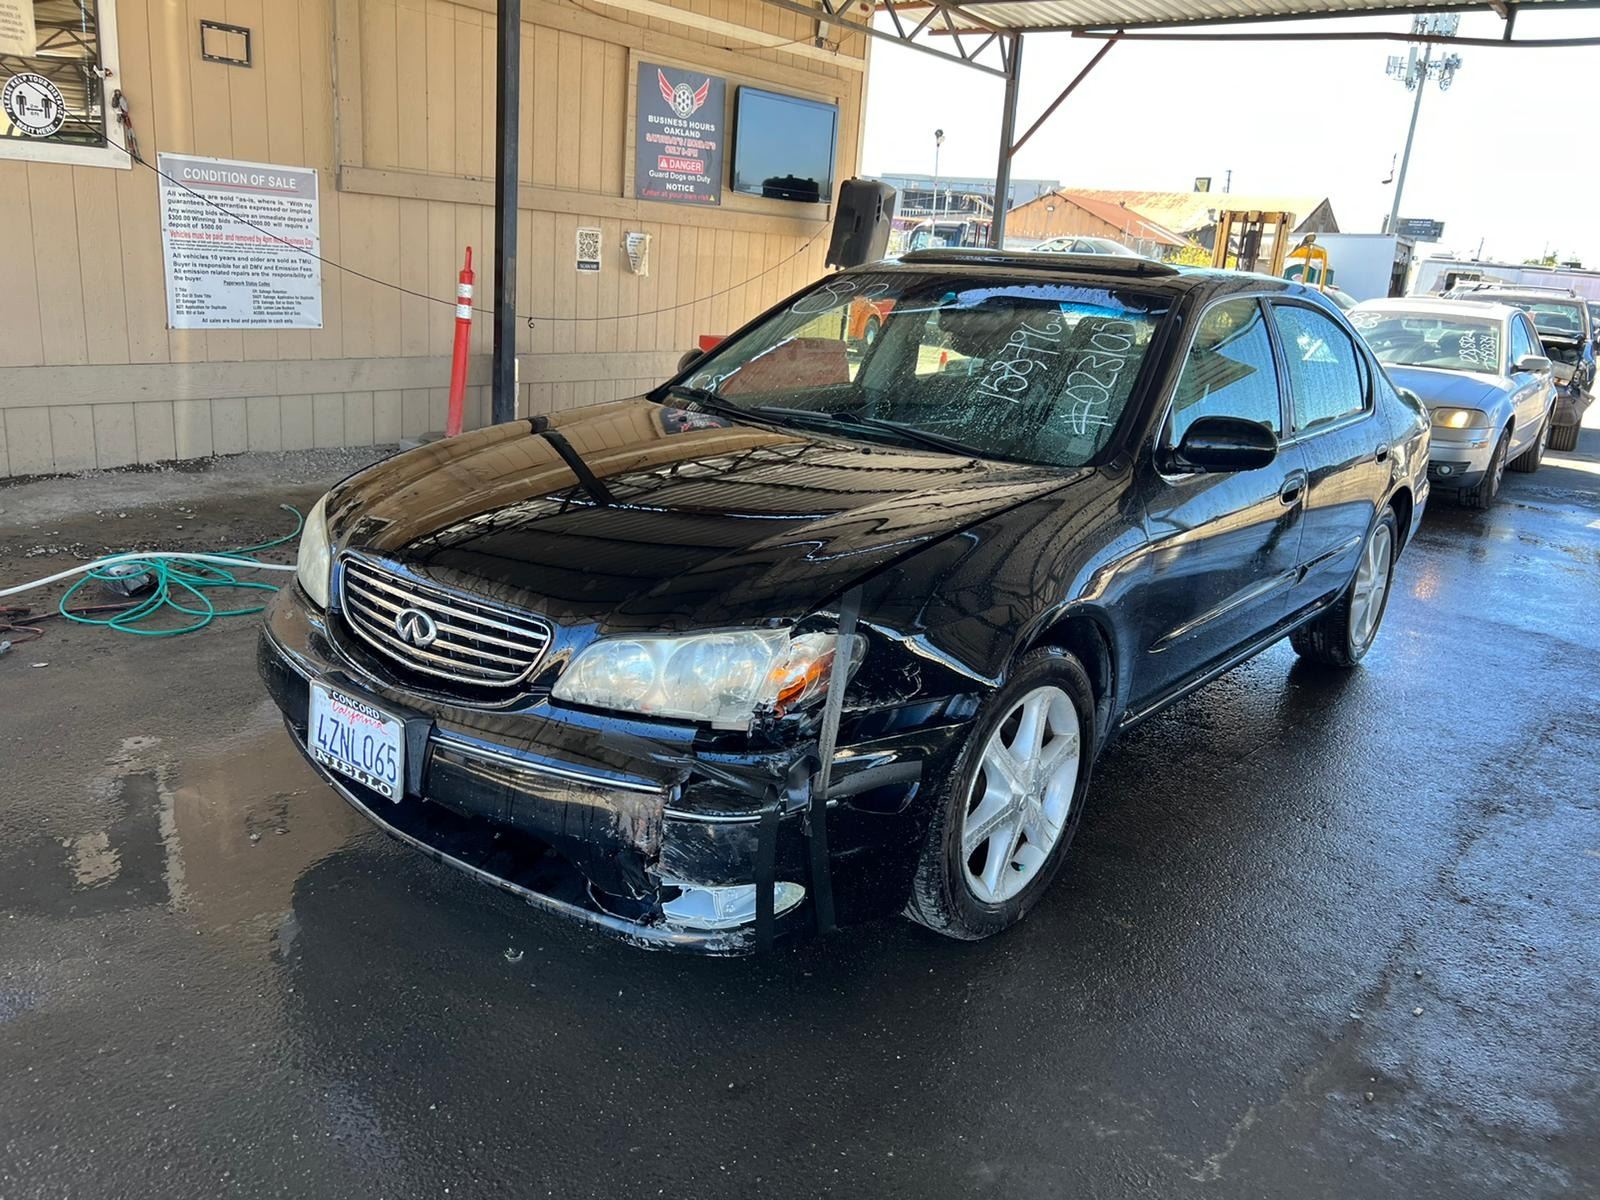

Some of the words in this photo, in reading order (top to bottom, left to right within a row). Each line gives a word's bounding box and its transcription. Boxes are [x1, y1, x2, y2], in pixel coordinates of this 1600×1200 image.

[29, 75, 49, 87] YOUR
[16, 120, 35, 135] WAIT
[36, 123, 56, 135] HERE
[647, 115, 688, 128] BUSINESS
[689, 121, 715, 132] HOURS
[663, 126, 701, 138] OAKLAND
[669, 159, 701, 171] DANGER
[183, 167, 248, 185] CONDITION
[250, 174, 265, 186] OF
[268, 176, 297, 189] SALE
[648, 169, 669, 178] Guard
[669, 171, 687, 182] Dogs
[696, 174, 711, 185] Duty
[665, 182, 695, 192] NOTICE
[181, 208, 204, 216] winning
[249, 204, 280, 212] expressed
[167, 213, 191, 221] $300.00
[191, 215, 216, 224] Winning
[168, 221, 191, 229] deposit
[332, 691, 380, 719] CONCORD
[331, 700, 388, 736] California
[318, 713, 397, 783] 4ZNL065
[316, 748, 392, 797] NIELLO
